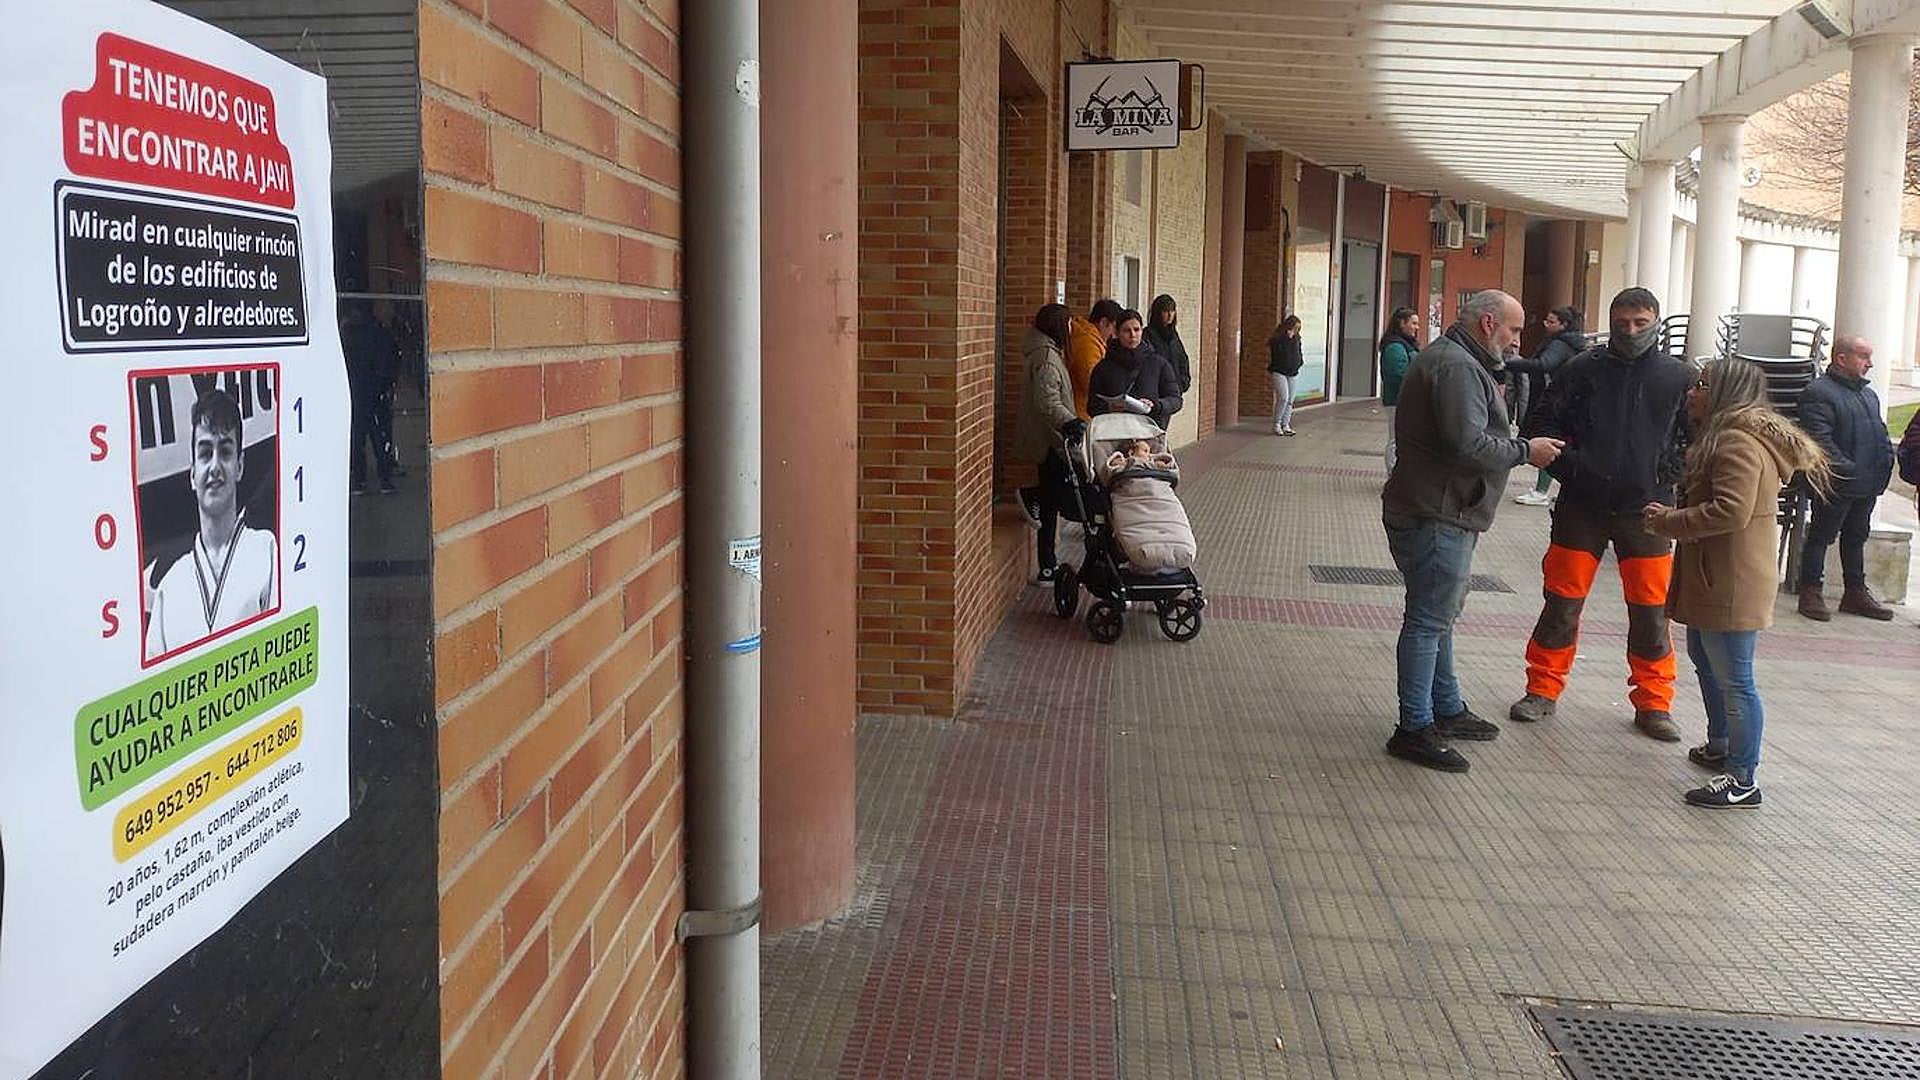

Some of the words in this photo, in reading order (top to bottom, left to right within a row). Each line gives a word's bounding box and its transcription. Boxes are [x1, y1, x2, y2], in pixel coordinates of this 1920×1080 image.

[109, 58, 229, 123] TENEMOS
[234, 96, 268, 136] QUE
[1076, 108, 1106, 127] LA
[1112, 107, 1173, 126] MINA
[1112, 128, 1139, 136] BAR
[78, 117, 239, 182] ENCONTRAR
[243, 155, 257, 187] A
[259, 157, 290, 194] JAVI
[69, 209, 136, 243] Mirad
[143, 222, 168, 246] en
[174, 224, 252, 257] cualquier
[256, 233, 296, 258] rincón
[107, 254, 136, 285] de
[143, 256, 175, 287] los
[181, 260, 256, 290] edificios
[259, 265, 278, 291] de
[77, 294, 172, 335] Logroño
[176, 305, 191, 334] y
[194, 299, 299, 328] alrededores.
[88, 727, 175, 793] AYUDAR
[180, 715, 193, 742] A
[198, 652, 313, 732] ENCONTRARLE
[89, 671, 208, 747] CUALQUIER
[214, 648, 260, 688] PISTA
[264, 622, 311, 663] PUEDE
[125, 807, 154, 843] 649
[157, 789, 184, 825] 952
[187, 772, 212, 806] 957
[226, 747, 250, 779] 644
[252, 734, 275, 762] 712
[276, 719, 298, 748] 806
[107, 877, 124, 906] 20
[127, 861, 161, 891] años,
[164, 838, 189, 868] 1,62
[189, 829, 205, 850] m,
[207, 784, 267, 835] complexión
[268, 760, 304, 795] atlética,
[135, 885, 163, 919] pelo
[166, 849, 214, 891] castaño,
[217, 830, 233, 855] iba
[235, 807, 270, 840] vestido
[272, 793, 289, 812] con
[113, 903, 175, 958] sudadera
[177, 868, 219, 908] marrón
[221, 861, 229, 882] y
[230, 827, 275, 869] pantalón
[276, 808, 302, 834] beige.
